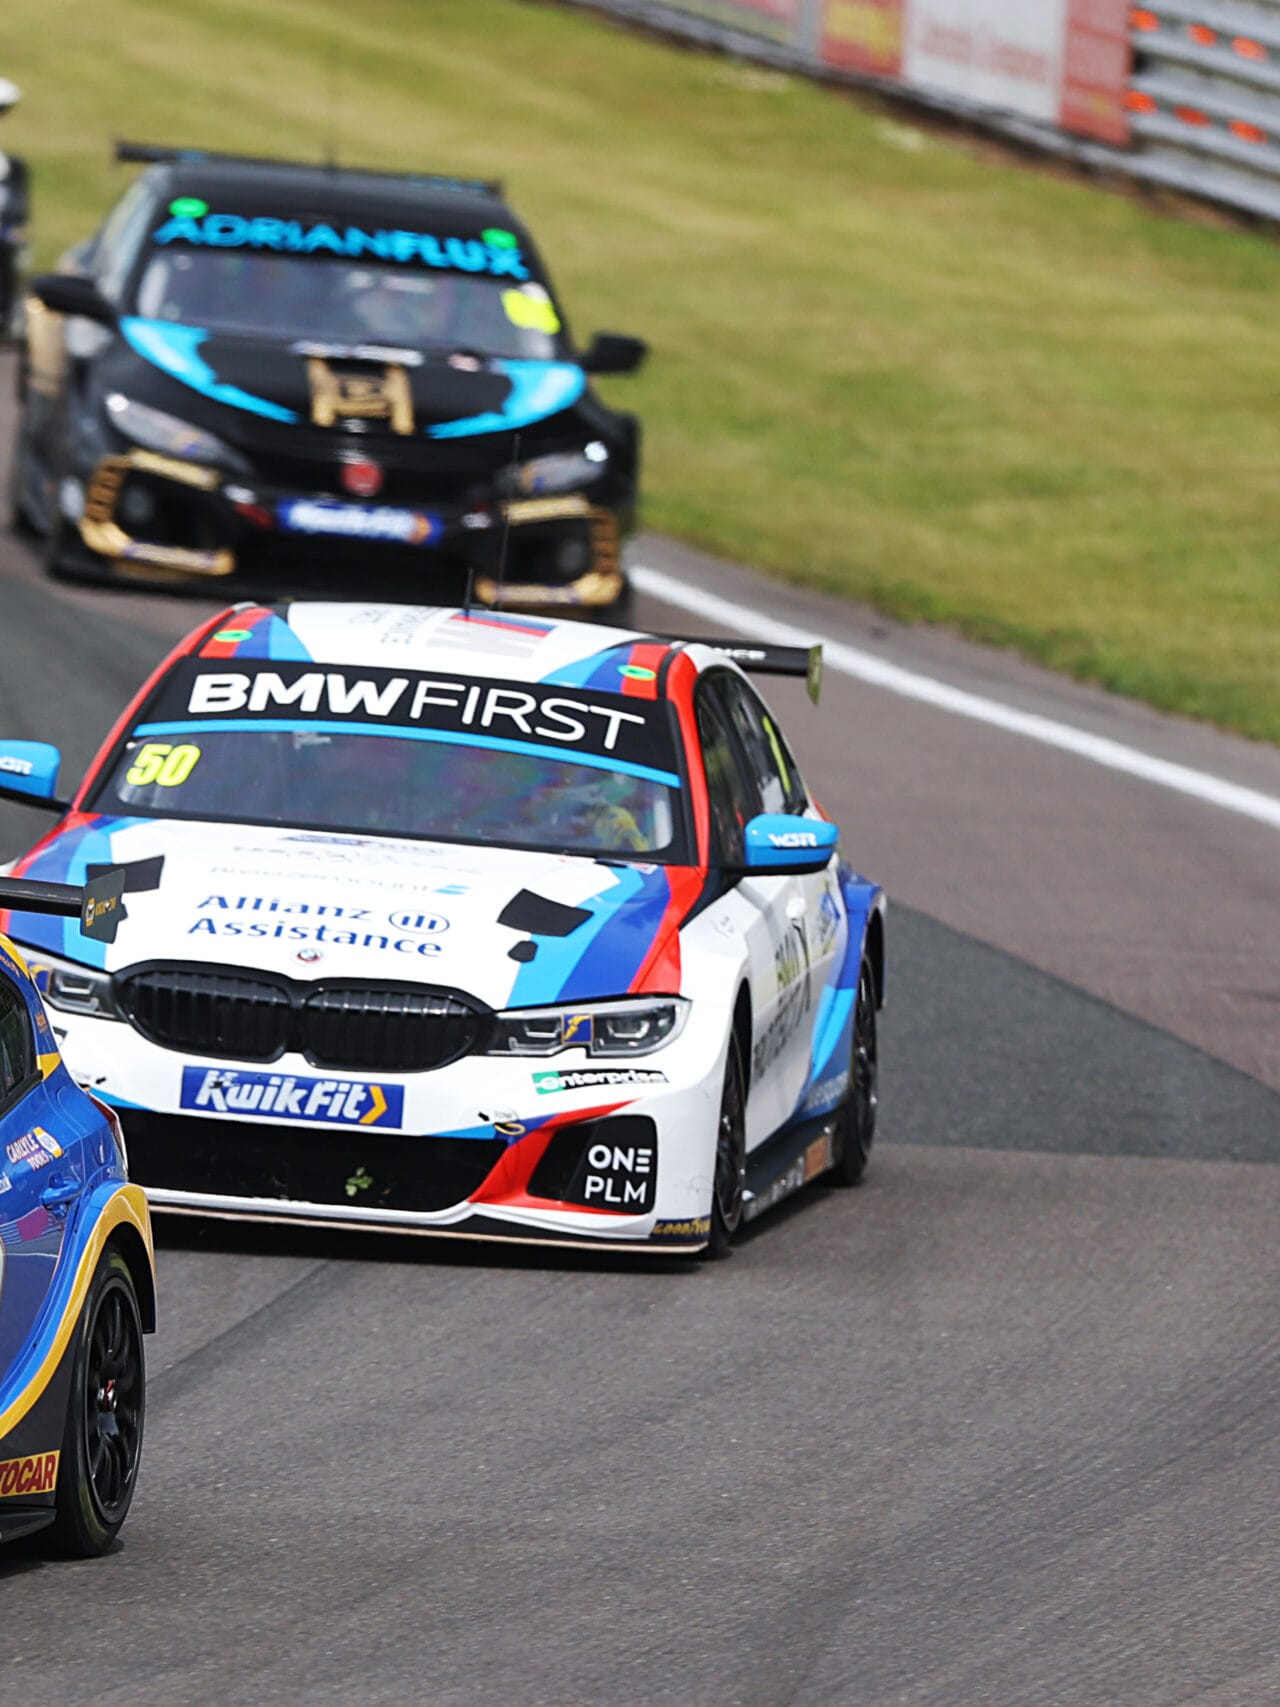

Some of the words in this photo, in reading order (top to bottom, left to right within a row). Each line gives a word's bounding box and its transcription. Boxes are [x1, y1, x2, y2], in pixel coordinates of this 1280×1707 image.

[126, 743, 201, 787] 50
[197, 895, 372, 921] Allianz
[187, 918, 444, 958] Assistance
[535, 1070, 665, 1091] enterprise
[588, 1145, 652, 1174] ONE
[585, 1175, 647, 1204] PLM
